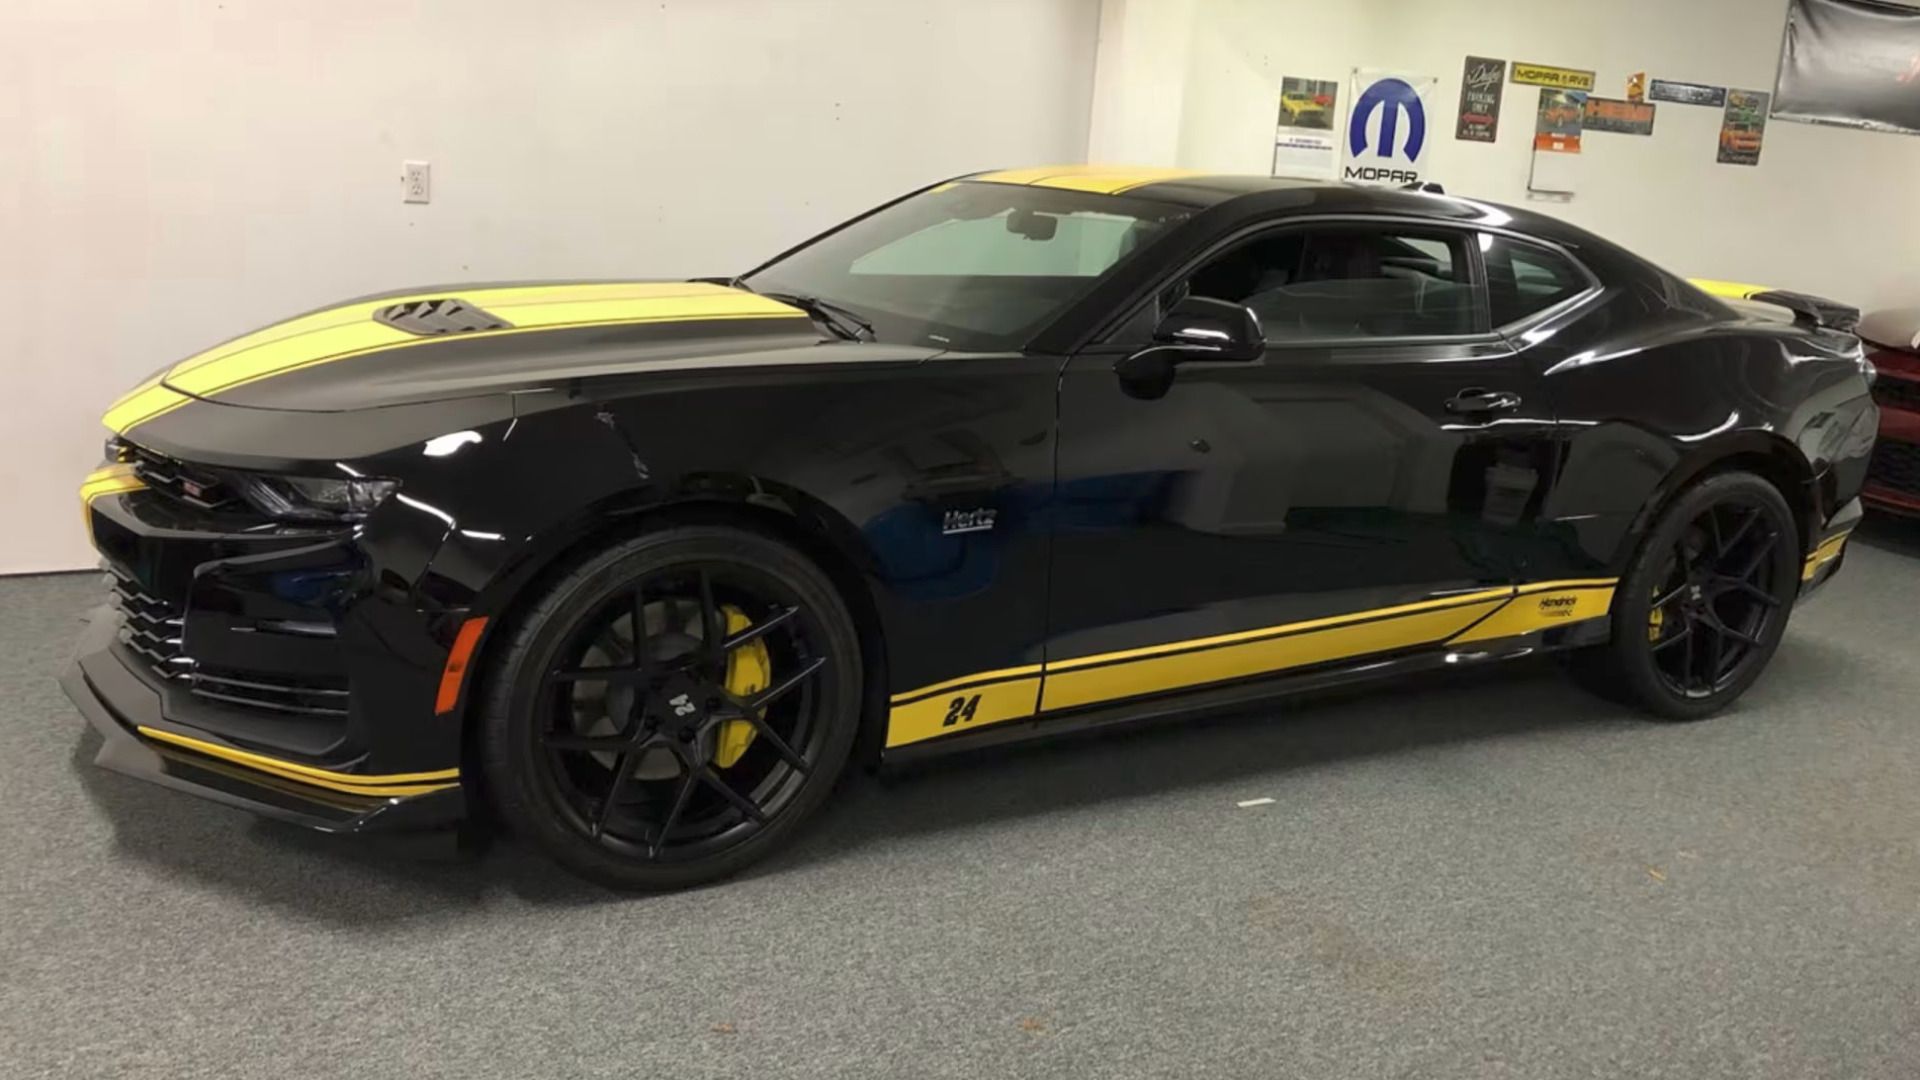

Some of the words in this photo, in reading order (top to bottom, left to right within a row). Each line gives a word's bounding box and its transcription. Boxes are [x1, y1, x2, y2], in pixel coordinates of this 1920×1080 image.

[1516, 69, 1560, 82] MOPAR
[1344, 166, 1418, 183] MOPAR
[943, 508, 998, 530] Hertz
[943, 694, 982, 727] 24
